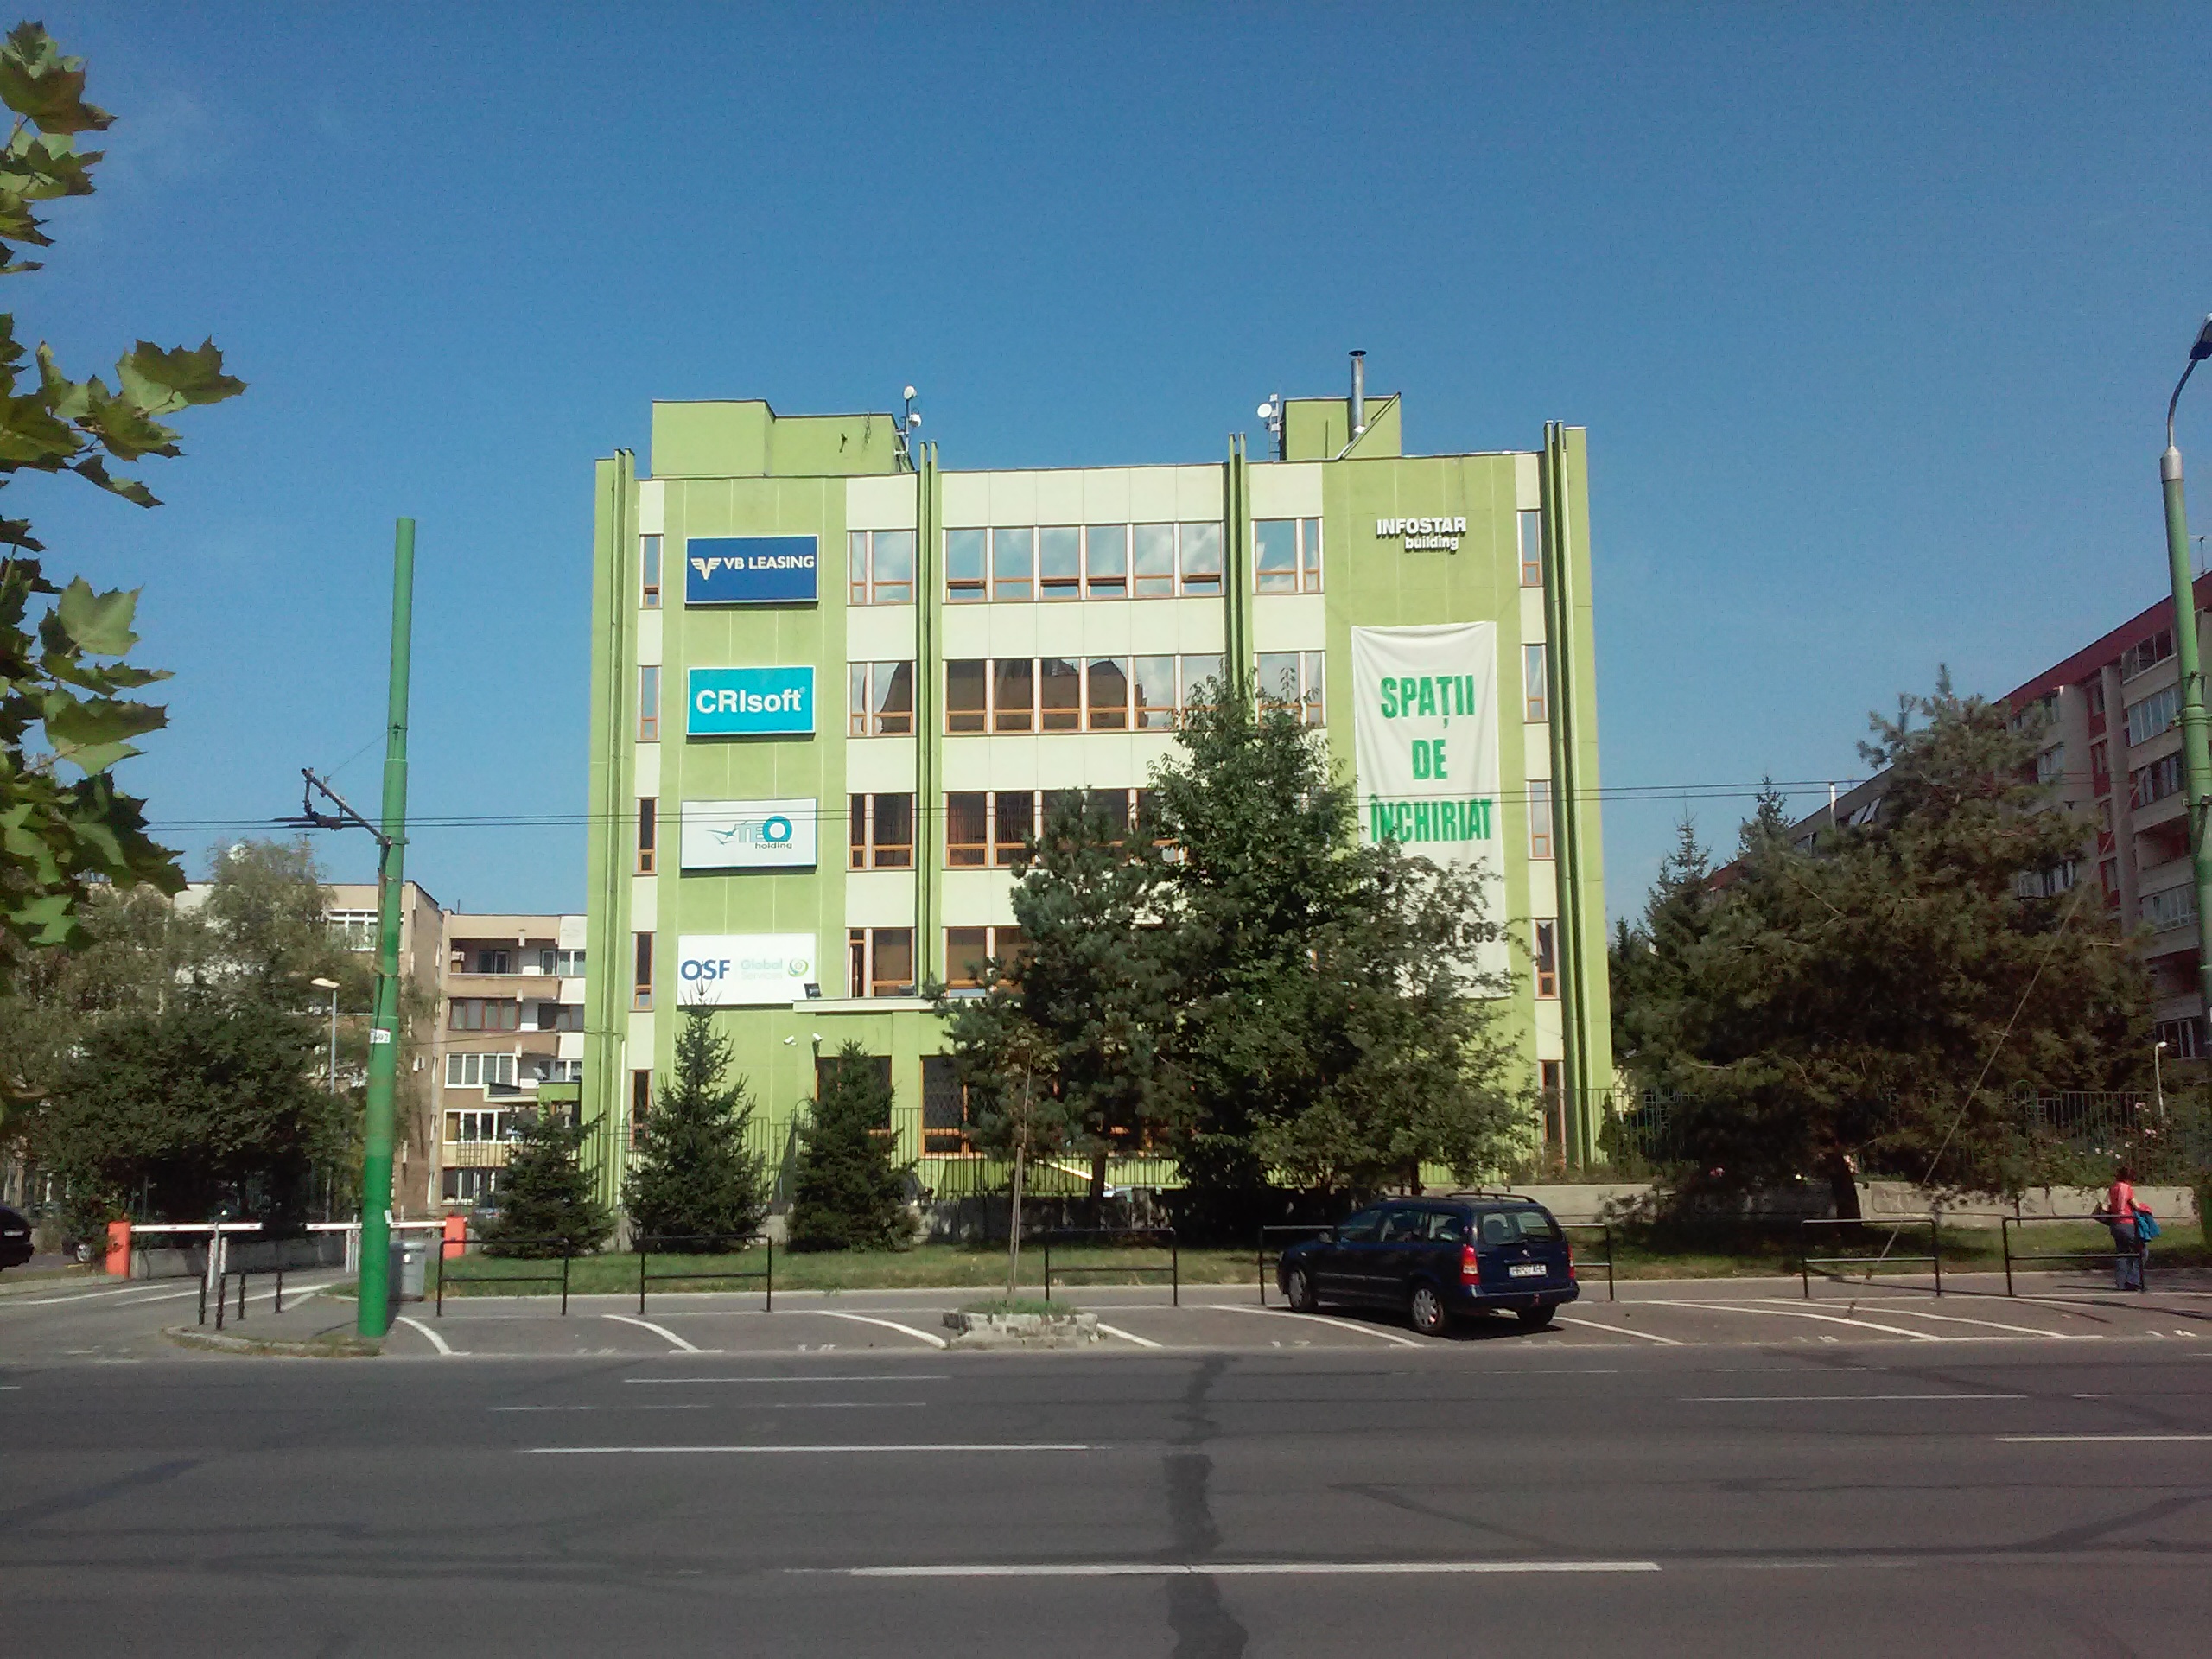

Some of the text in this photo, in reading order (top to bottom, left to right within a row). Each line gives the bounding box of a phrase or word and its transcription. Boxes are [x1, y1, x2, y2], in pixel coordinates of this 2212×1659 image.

[1376, 516, 1467, 535] INFOSTAR
[1404, 536, 1459, 550] building
[723, 556, 815, 570] VB LEASING
[1411, 738, 1448, 781] DE
[734, 815, 793, 842] TEO
[1369, 793, 1492, 842] ÎNCHIRIAT
[680, 958, 783, 981] OSF Global
